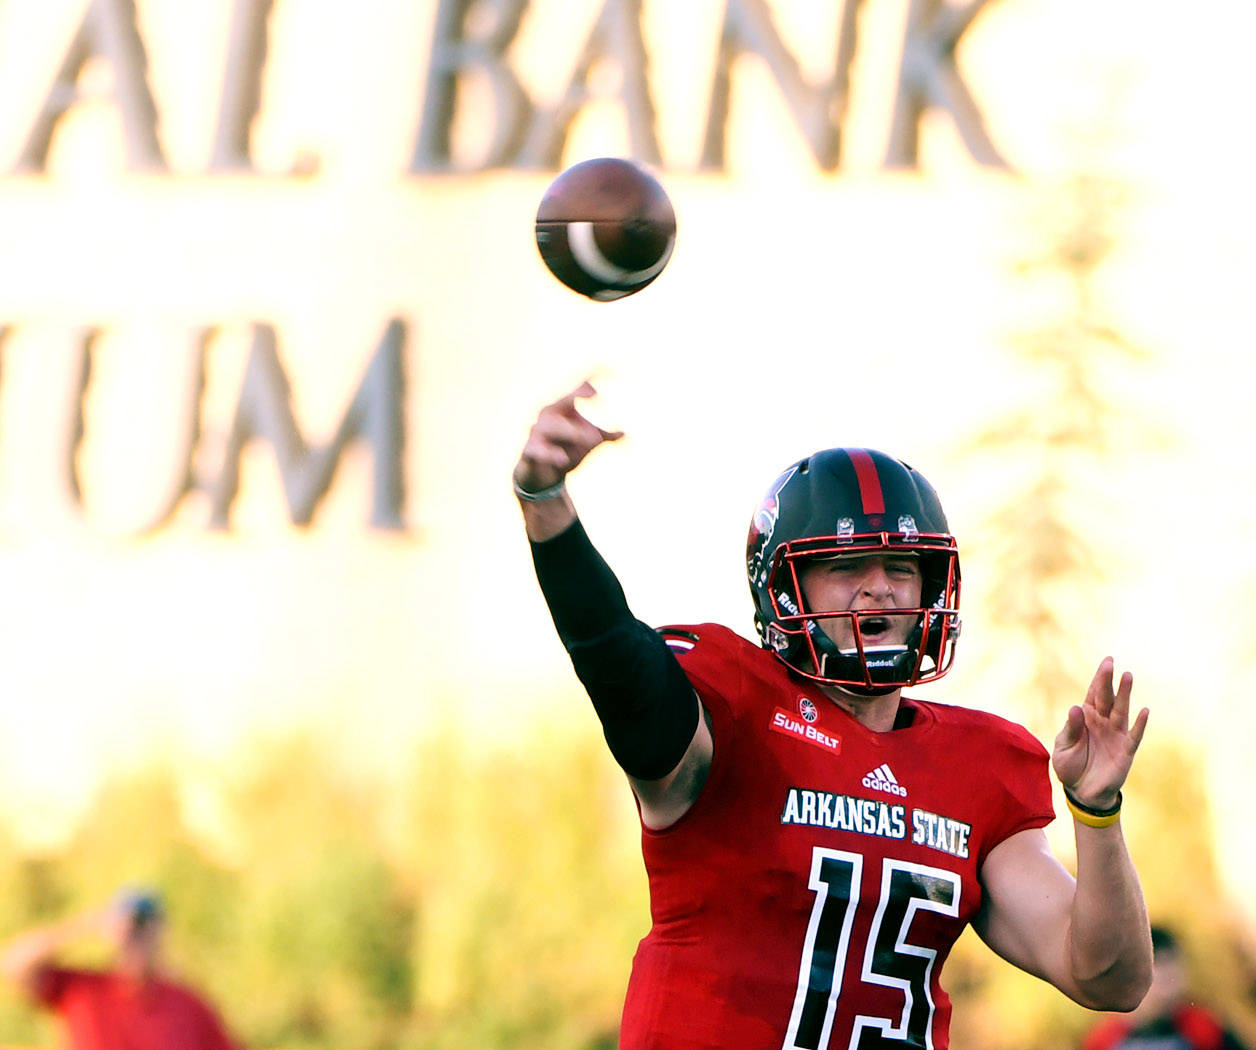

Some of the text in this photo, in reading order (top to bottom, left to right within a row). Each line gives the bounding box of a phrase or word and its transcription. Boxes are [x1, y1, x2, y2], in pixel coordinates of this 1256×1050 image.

[402, 0, 1017, 176] BANK
[0, 316, 416, 534] UM
[782, 787, 972, 860] ARKANSAS STATE
[862, 777, 908, 798] adidas
